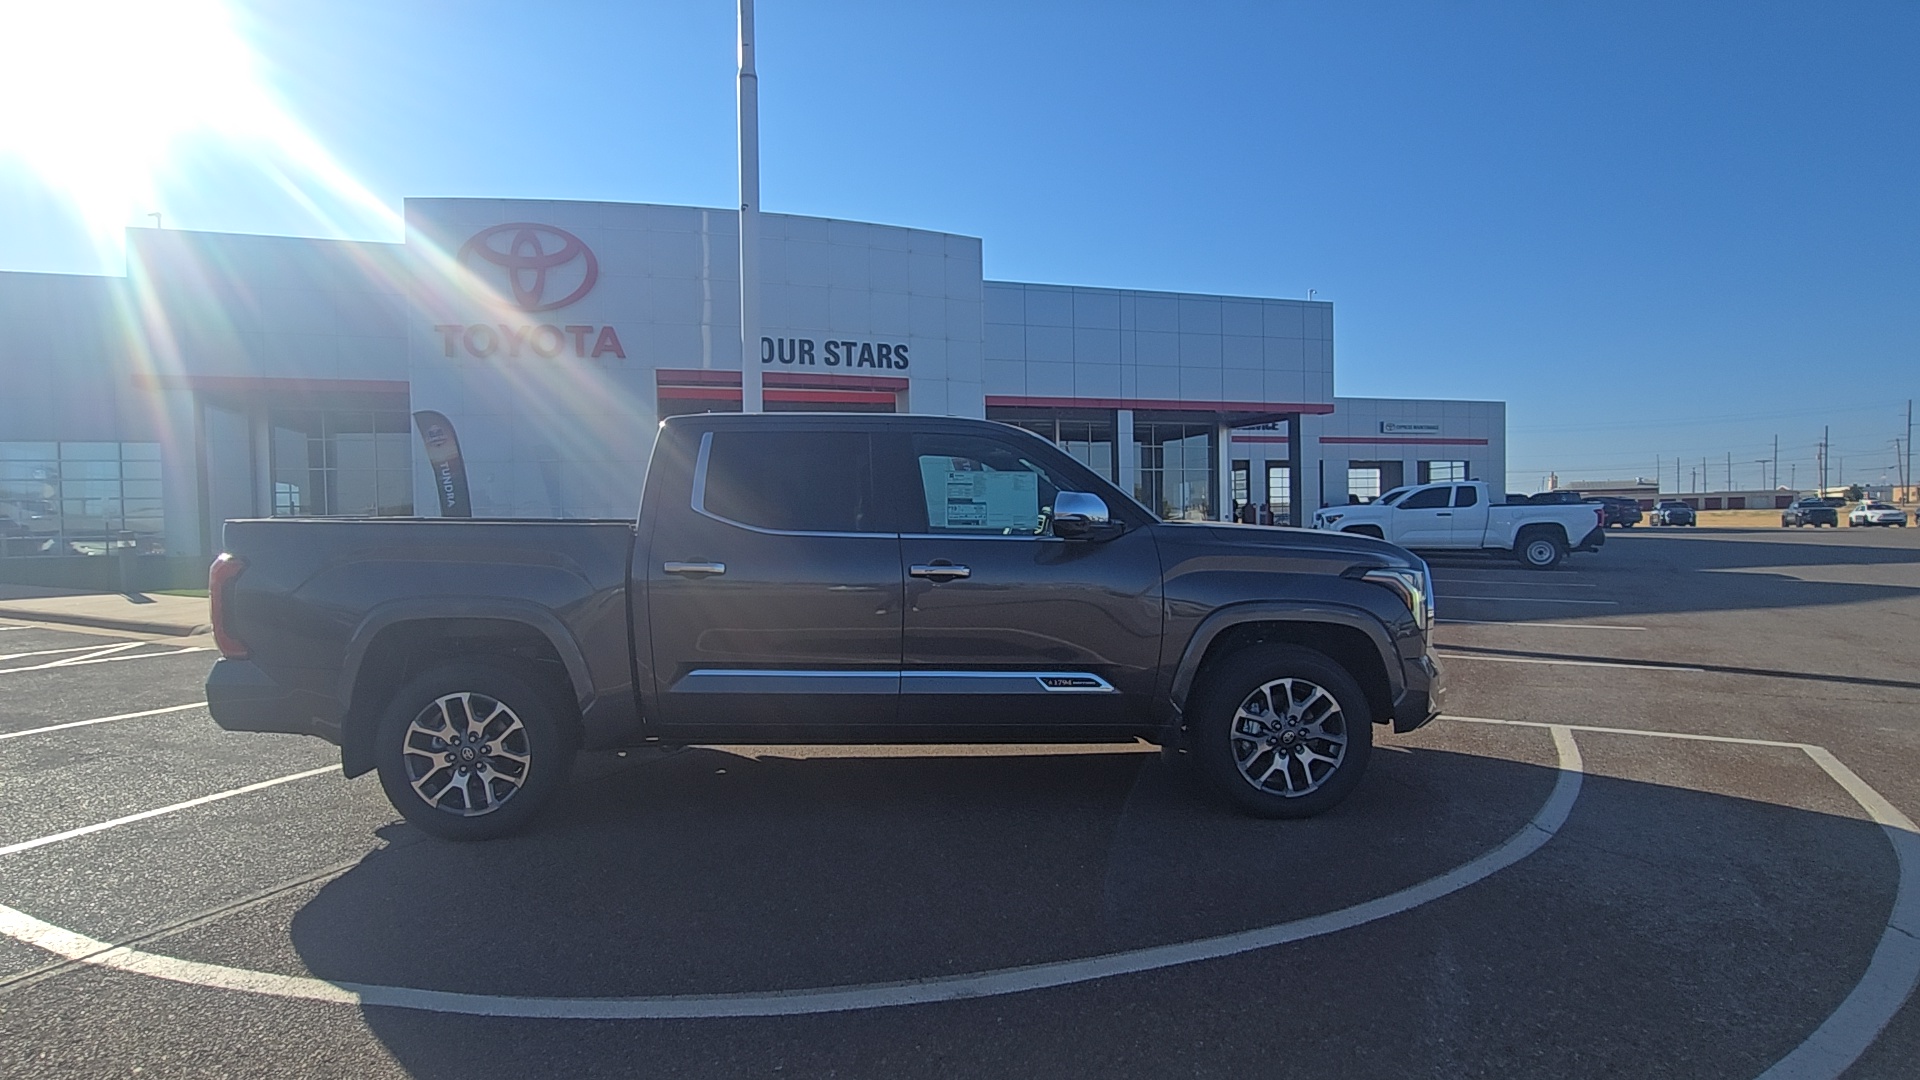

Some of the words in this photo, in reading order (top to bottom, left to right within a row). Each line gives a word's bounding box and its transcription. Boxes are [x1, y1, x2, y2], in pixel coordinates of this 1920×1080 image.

[434, 323, 627, 359] TOYOTA
[761, 337, 815, 366] OUR
[824, 340, 909, 370] STARS
[440, 461, 456, 508] TUNDRA
